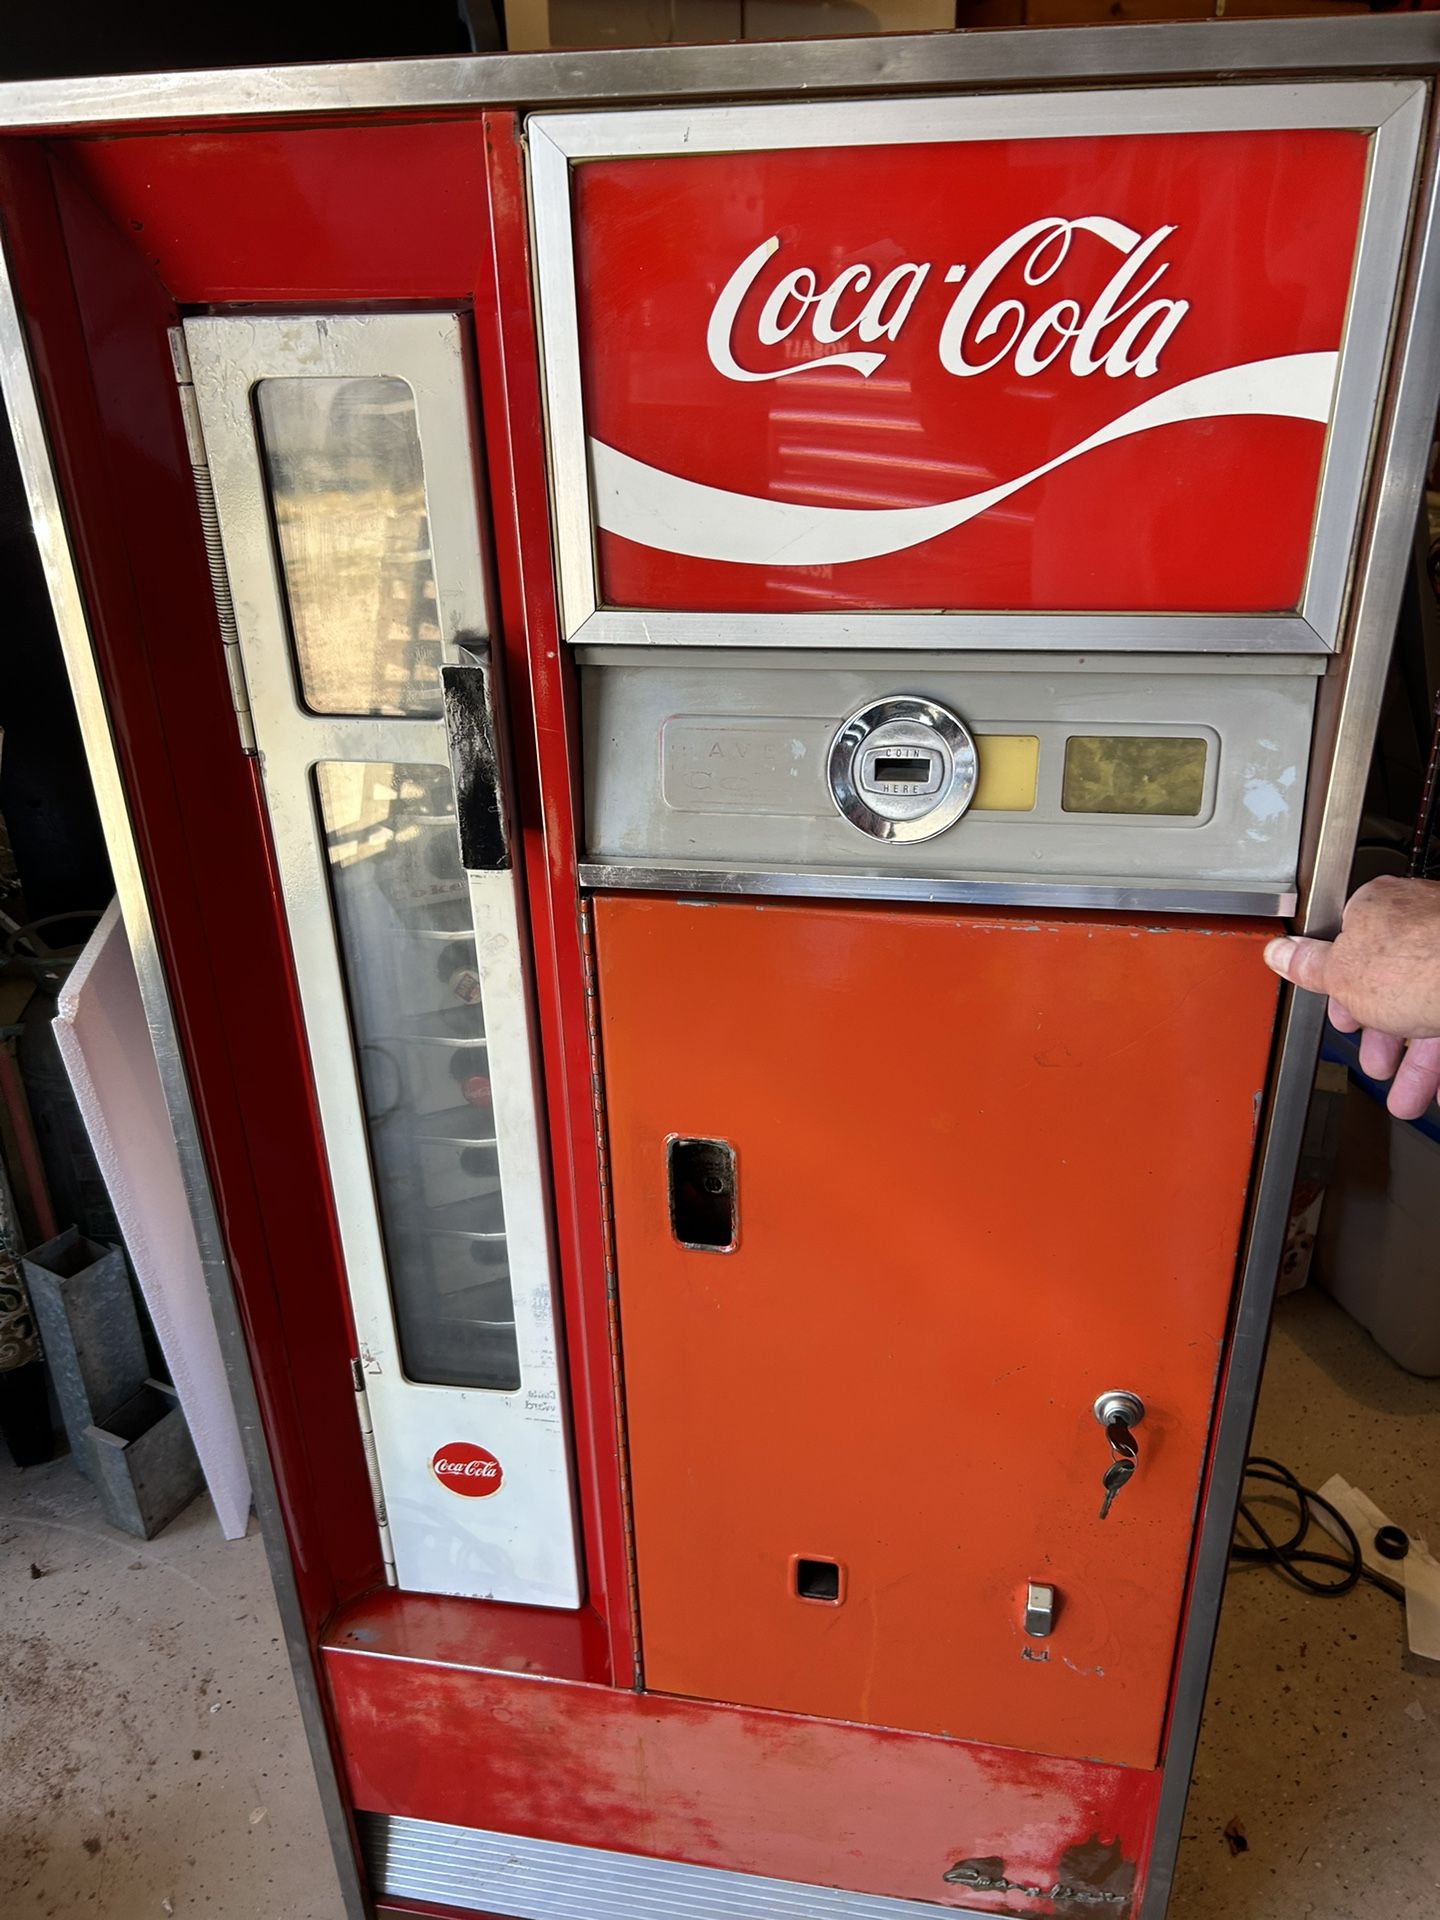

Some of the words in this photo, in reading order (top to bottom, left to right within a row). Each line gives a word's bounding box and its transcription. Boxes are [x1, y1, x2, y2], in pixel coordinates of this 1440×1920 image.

[706, 216, 1190, 382] Coca-Cola
[886, 748, 920, 758] COIN
[883, 784, 920, 794] HERE
[434, 1458, 498, 1478] Coca-Cola
